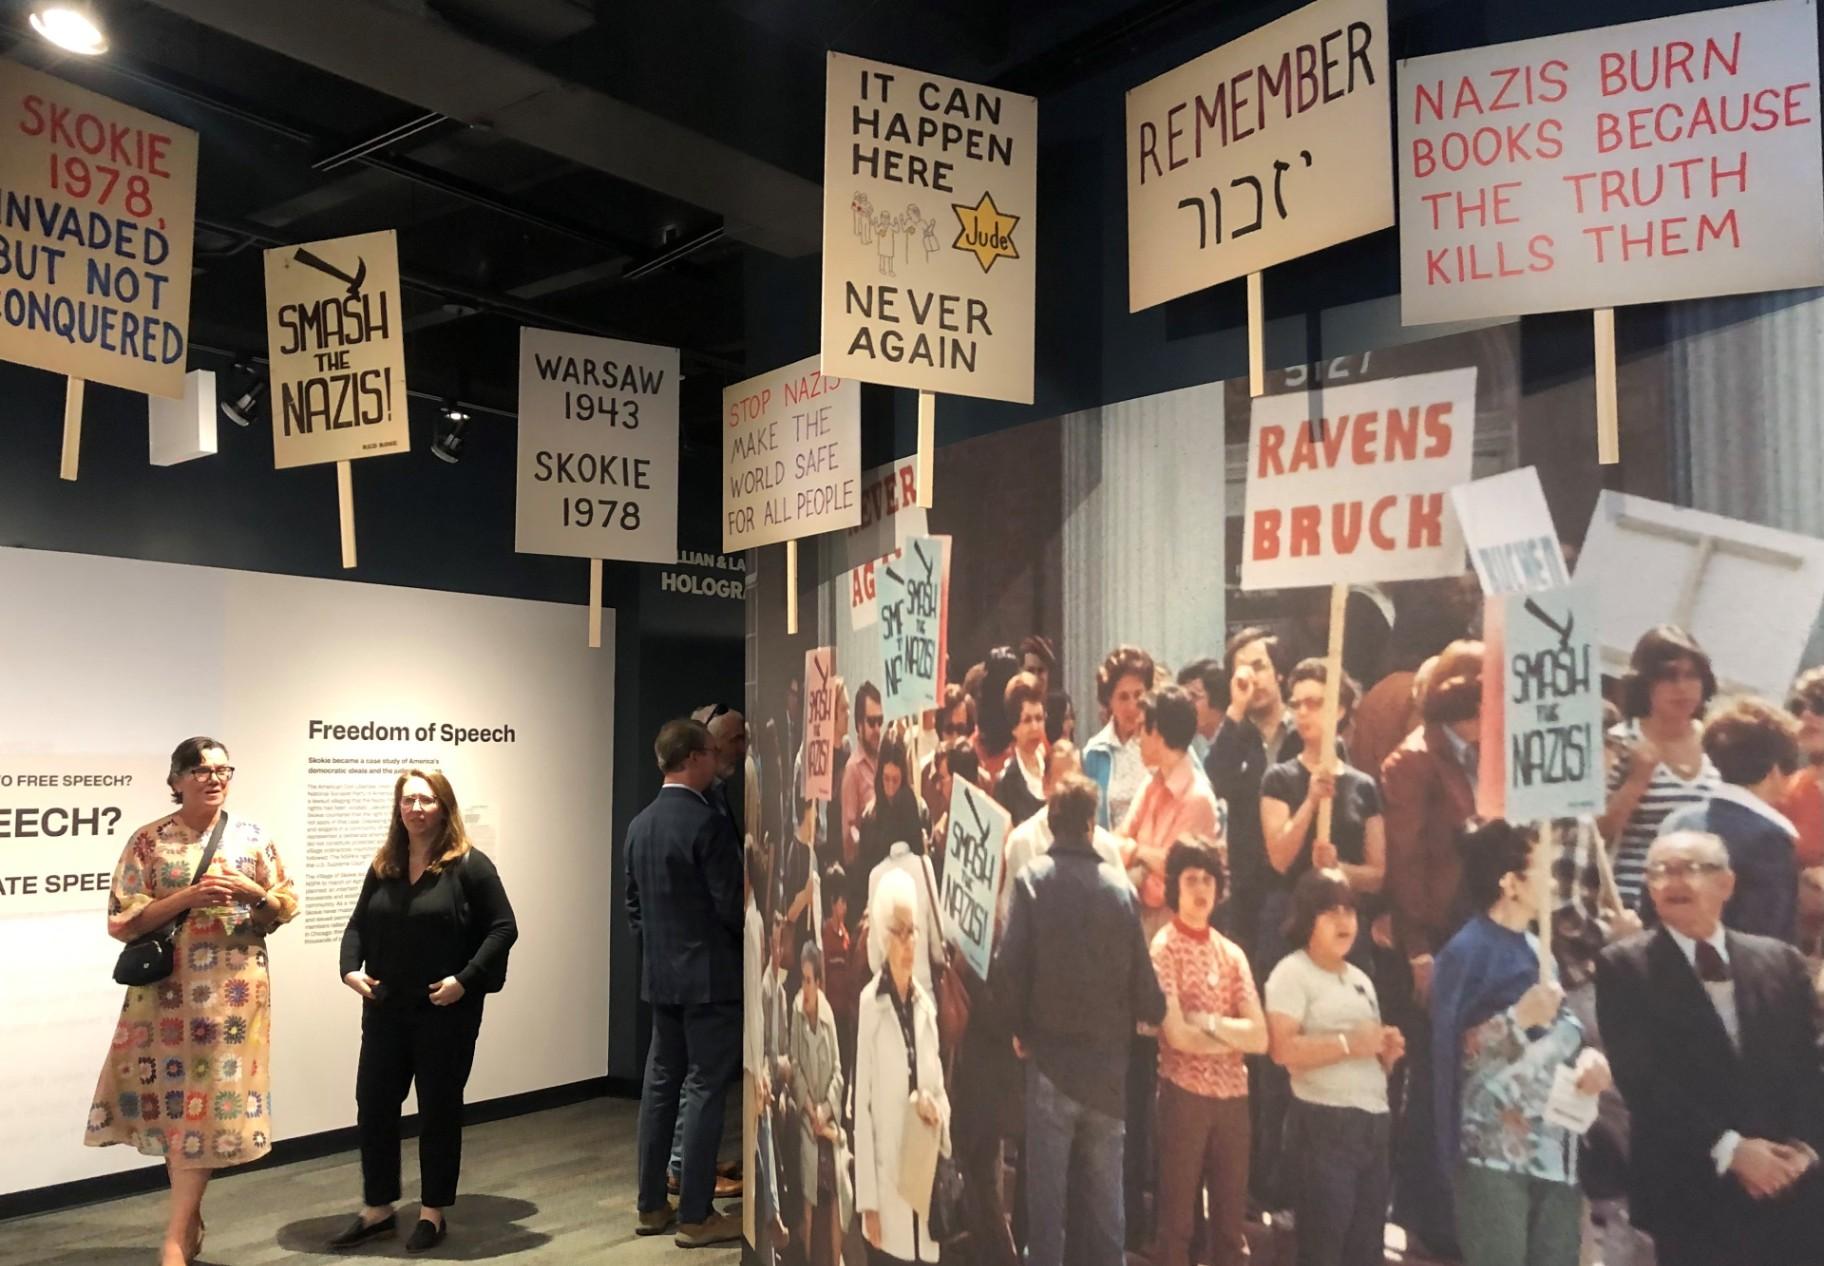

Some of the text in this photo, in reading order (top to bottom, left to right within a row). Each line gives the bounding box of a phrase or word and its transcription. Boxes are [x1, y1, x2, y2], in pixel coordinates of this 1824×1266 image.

[861, 70, 1001, 125] IT CAN
[1140, 21, 1375, 185] REMEMBER
[1415, 32, 1742, 125] NAZIS BURN
[19, 95, 172, 179] SKOKIE
[852, 105, 1013, 166] HAPPEN
[1412, 83, 1812, 178] BOOKS BECAUSE
[852, 143, 954, 193] HERE
[1421, 151, 1748, 230] THE TRUTH
[0, 190, 169, 265] NVADED
[1177, 150, 1312, 249] יזכור
[965, 215, 1009, 251] Jude
[1426, 209, 1740, 285] KILLS THEM
[87, 258, 169, 309] NOT
[846, 280, 993, 336] NEVER
[0, 288, 183, 364] ONQUERED
[278, 290, 389, 354] SMASH
[847, 326, 977, 373] AGAIN
[313, 350, 350, 372] THE
[535, 353, 664, 394] WARSAW
[282, 367, 392, 436] NAZIS!
[565, 391, 639, 429] 1943
[729, 389, 771, 427] STOP
[730, 406, 832, 464] MAKE THE
[1257, 401, 1453, 479] RAVENS
[534, 451, 650, 490] SKOKIE
[730, 442, 838, 499] WORLD SAFE
[563, 497, 640, 530] 1978
[728, 479, 853, 535] FOR ALL PEOPLE
[1252, 492, 1444, 561] BRUCK
[661, 572, 746, 599] HOLOGR
[716, 555, 726, 569] &
[1512, 643, 1591, 704] SMASH
[309, 720, 516, 746] Freedom of Speech
[17, 775, 59, 787] FREE
[62, 775, 133, 787] SPEECH?
